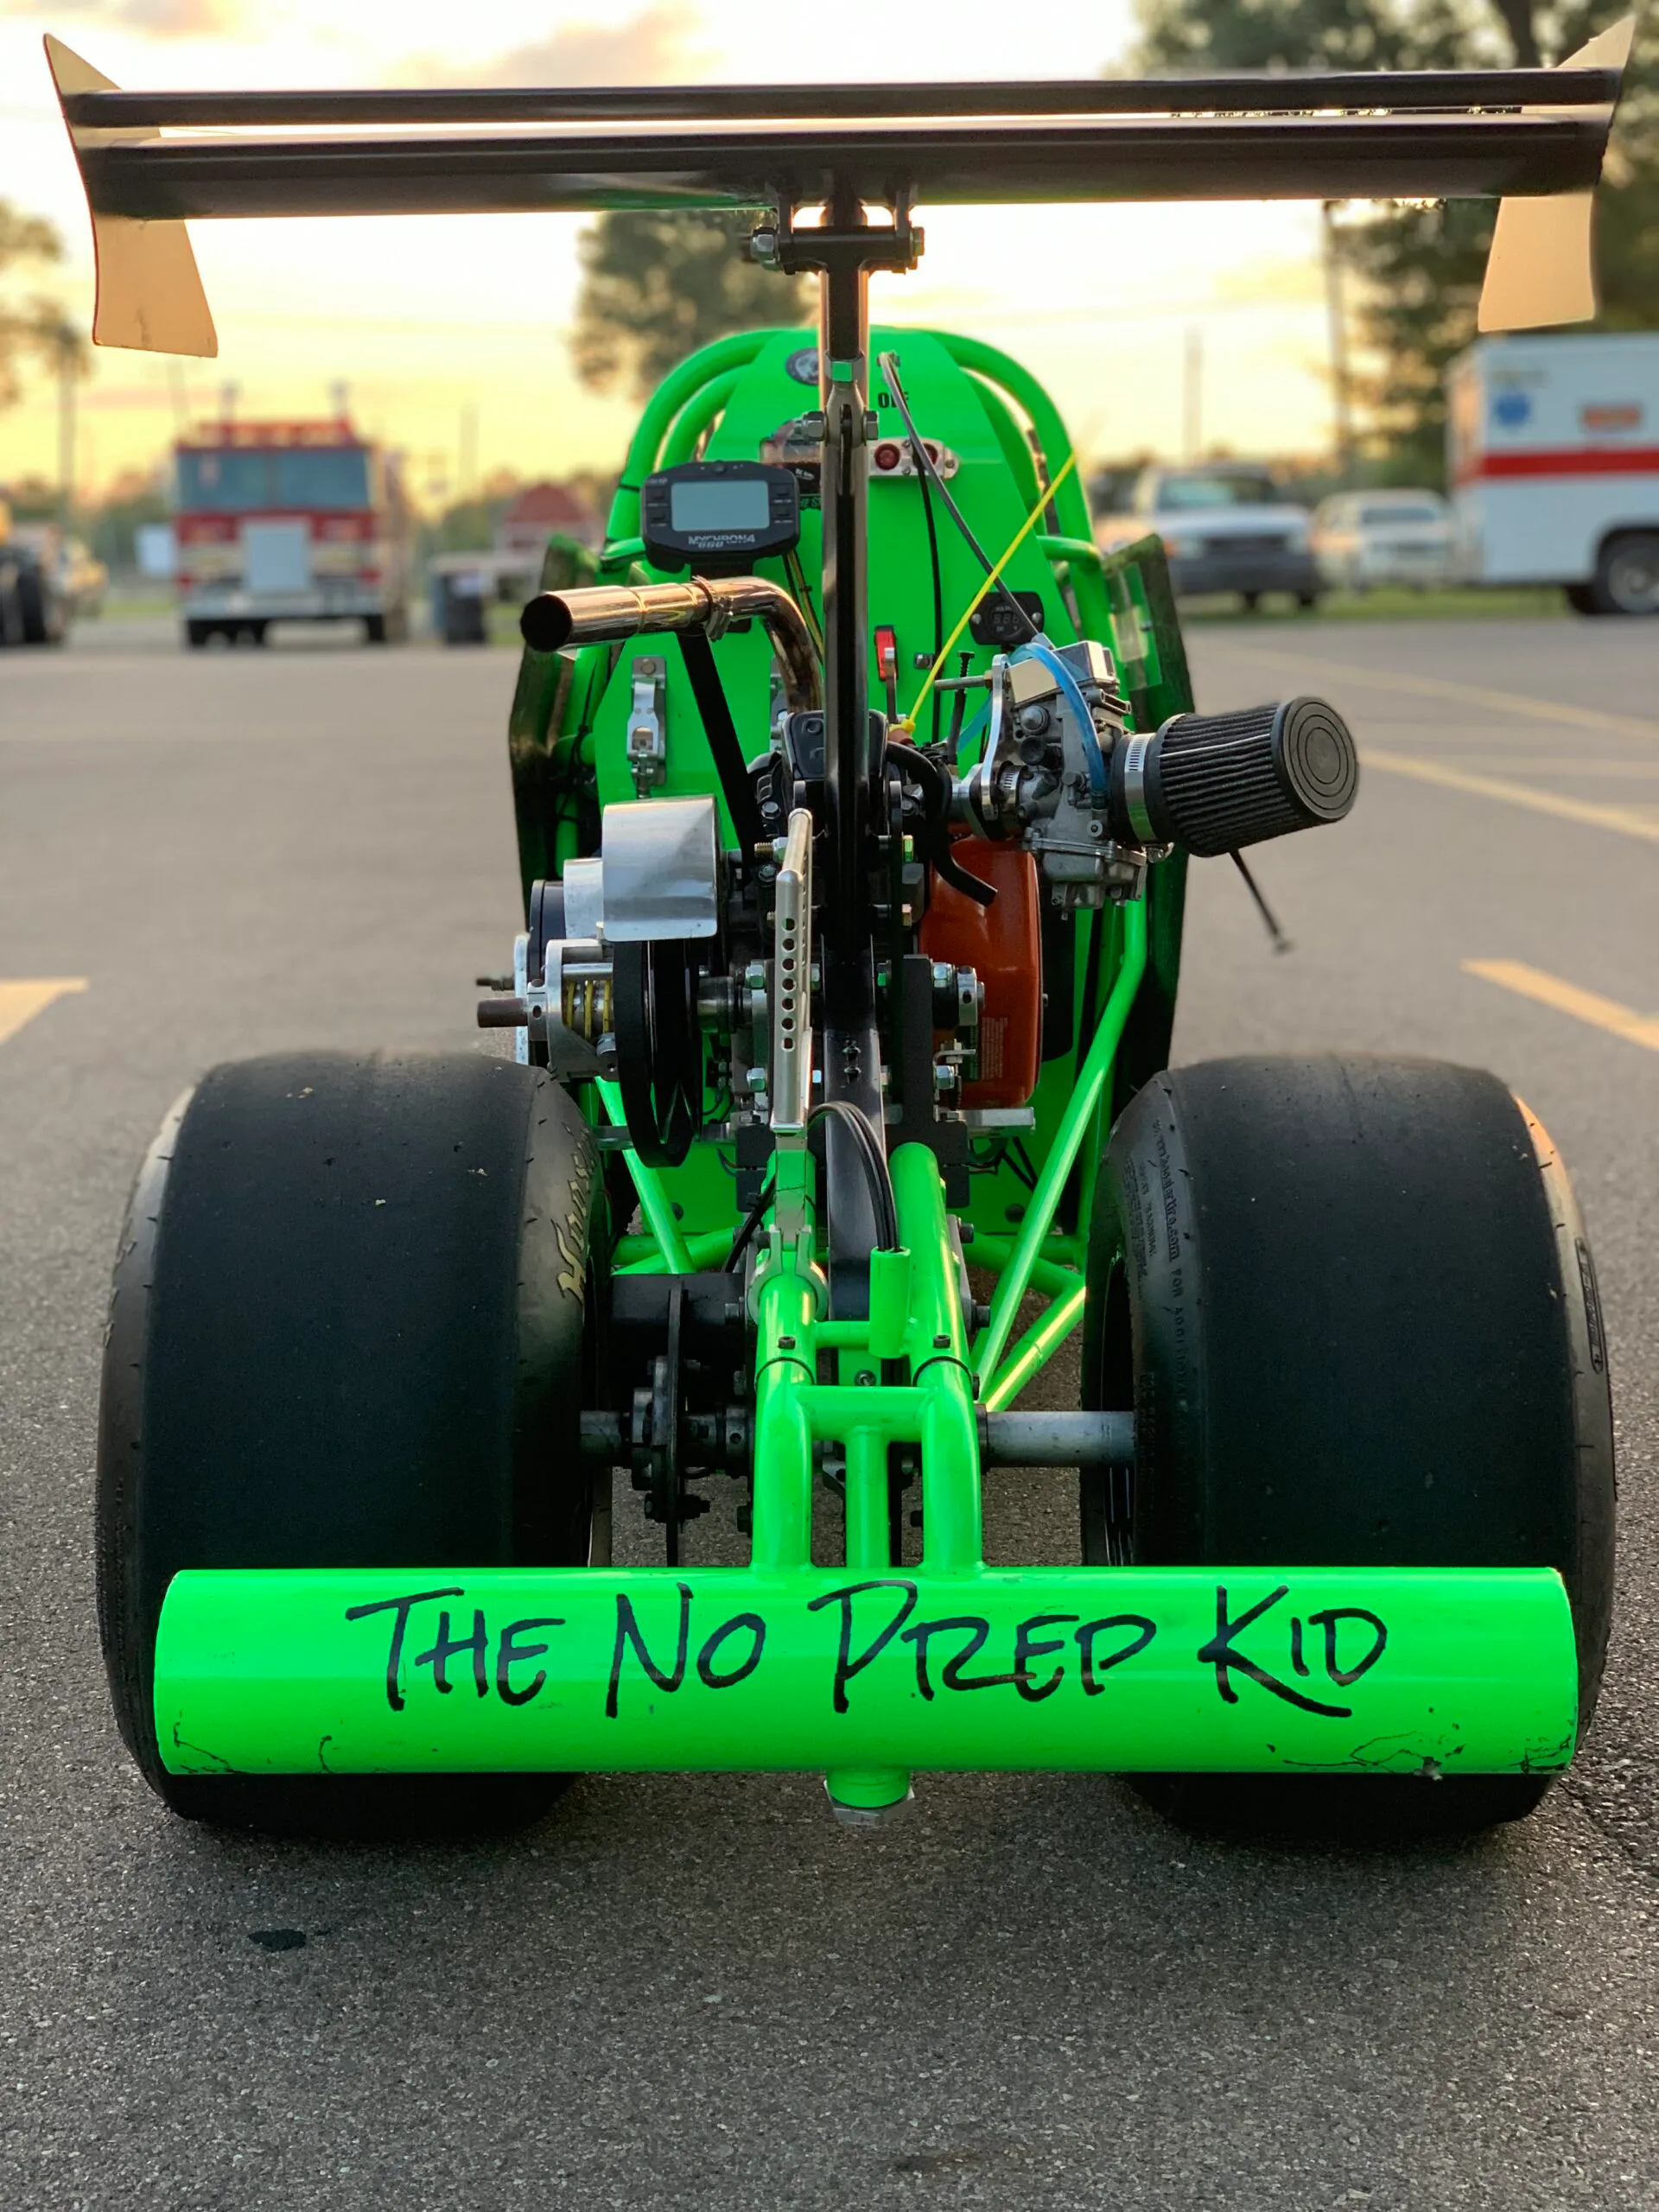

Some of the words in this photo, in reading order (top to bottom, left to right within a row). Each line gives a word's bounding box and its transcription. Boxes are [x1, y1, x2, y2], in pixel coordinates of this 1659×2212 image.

[346, 1587, 566, 1713] THE
[605, 1582, 766, 1719] NO
[807, 1581, 1157, 1714] PREP
[1196, 1586, 1388, 1719] KID
